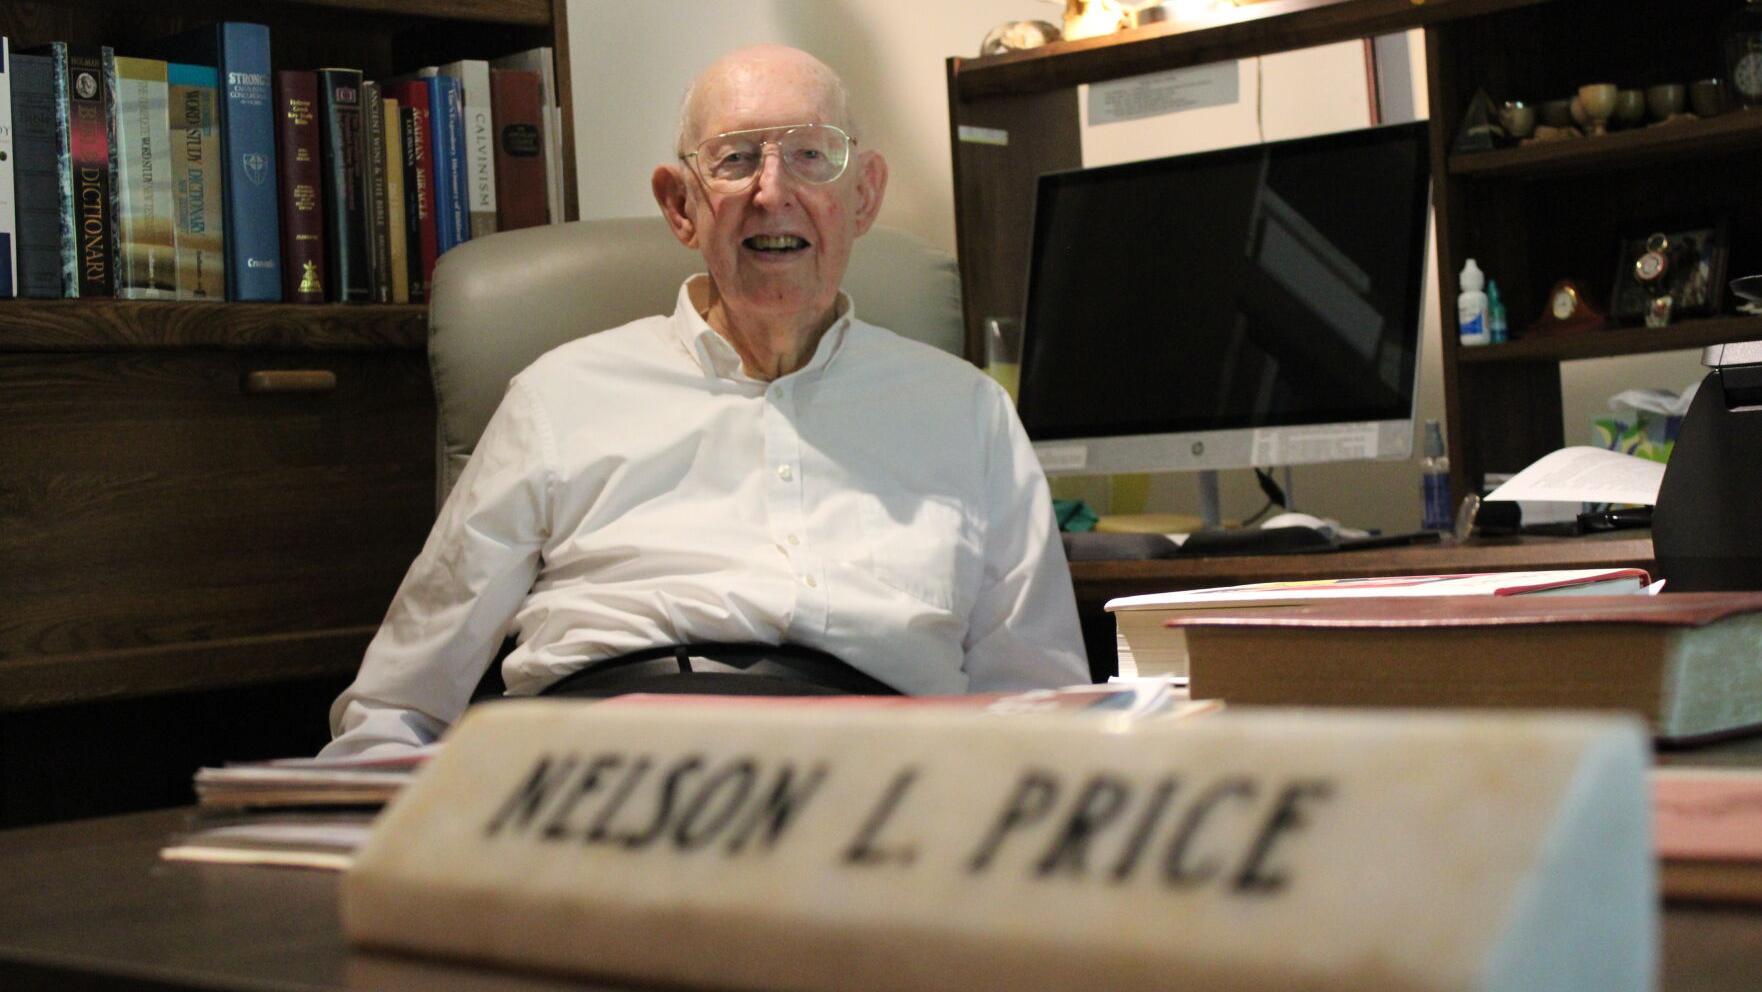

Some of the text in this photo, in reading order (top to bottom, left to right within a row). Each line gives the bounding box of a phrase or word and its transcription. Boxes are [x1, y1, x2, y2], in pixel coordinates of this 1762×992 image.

[185, 90, 205, 233] WORD STUDY DICTIONARY
[370, 88, 381, 133] ANCIENT
[376, 199, 385, 226] BIBLE
[412, 106, 429, 220] ACADIAN MIRACLE
[475, 112, 489, 207] CALVINISM
[81, 167, 105, 284] DICTIONARY
[484, 753, 830, 858] NELSON
[967, 767, 1334, 897] PRICE
